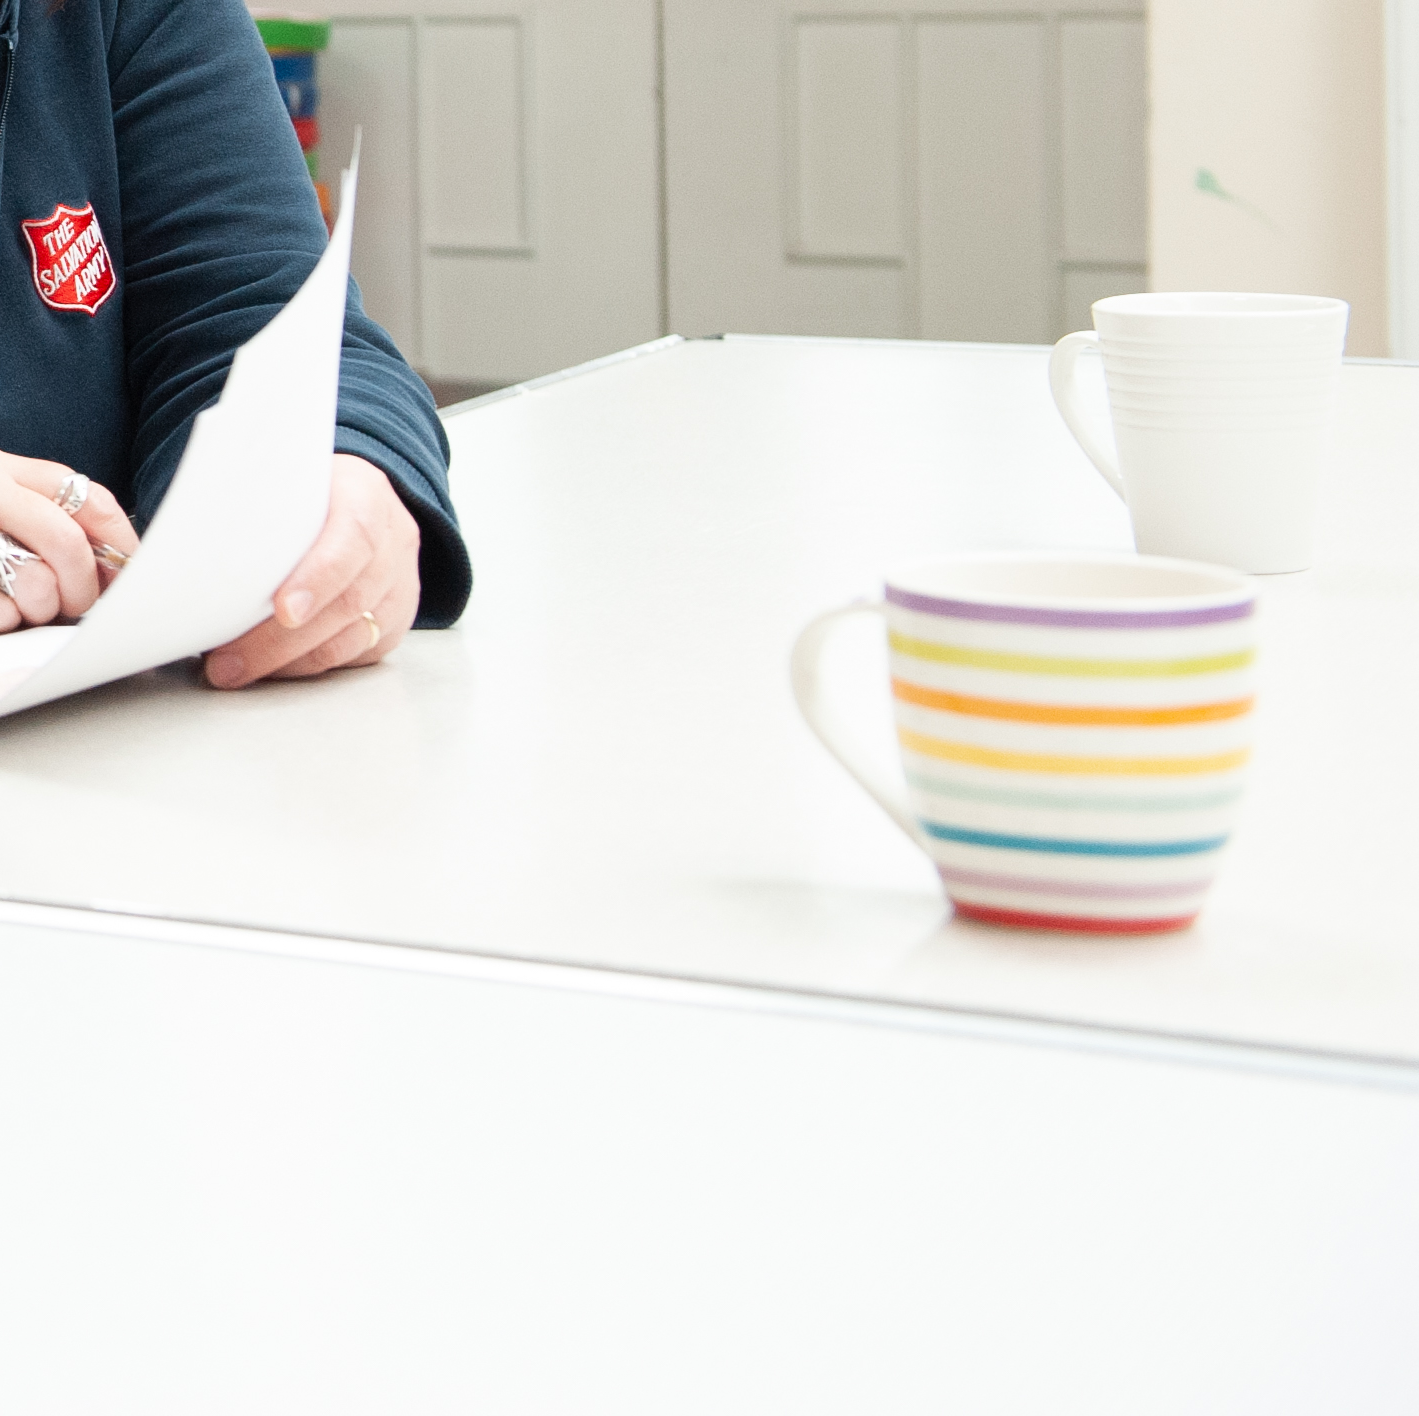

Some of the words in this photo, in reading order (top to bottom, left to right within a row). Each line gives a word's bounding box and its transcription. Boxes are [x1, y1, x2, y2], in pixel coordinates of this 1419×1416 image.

[40, 220, 101, 297] SALVATION
[43, 217, 75, 256] THE
[74, 246, 107, 302] ARMY
